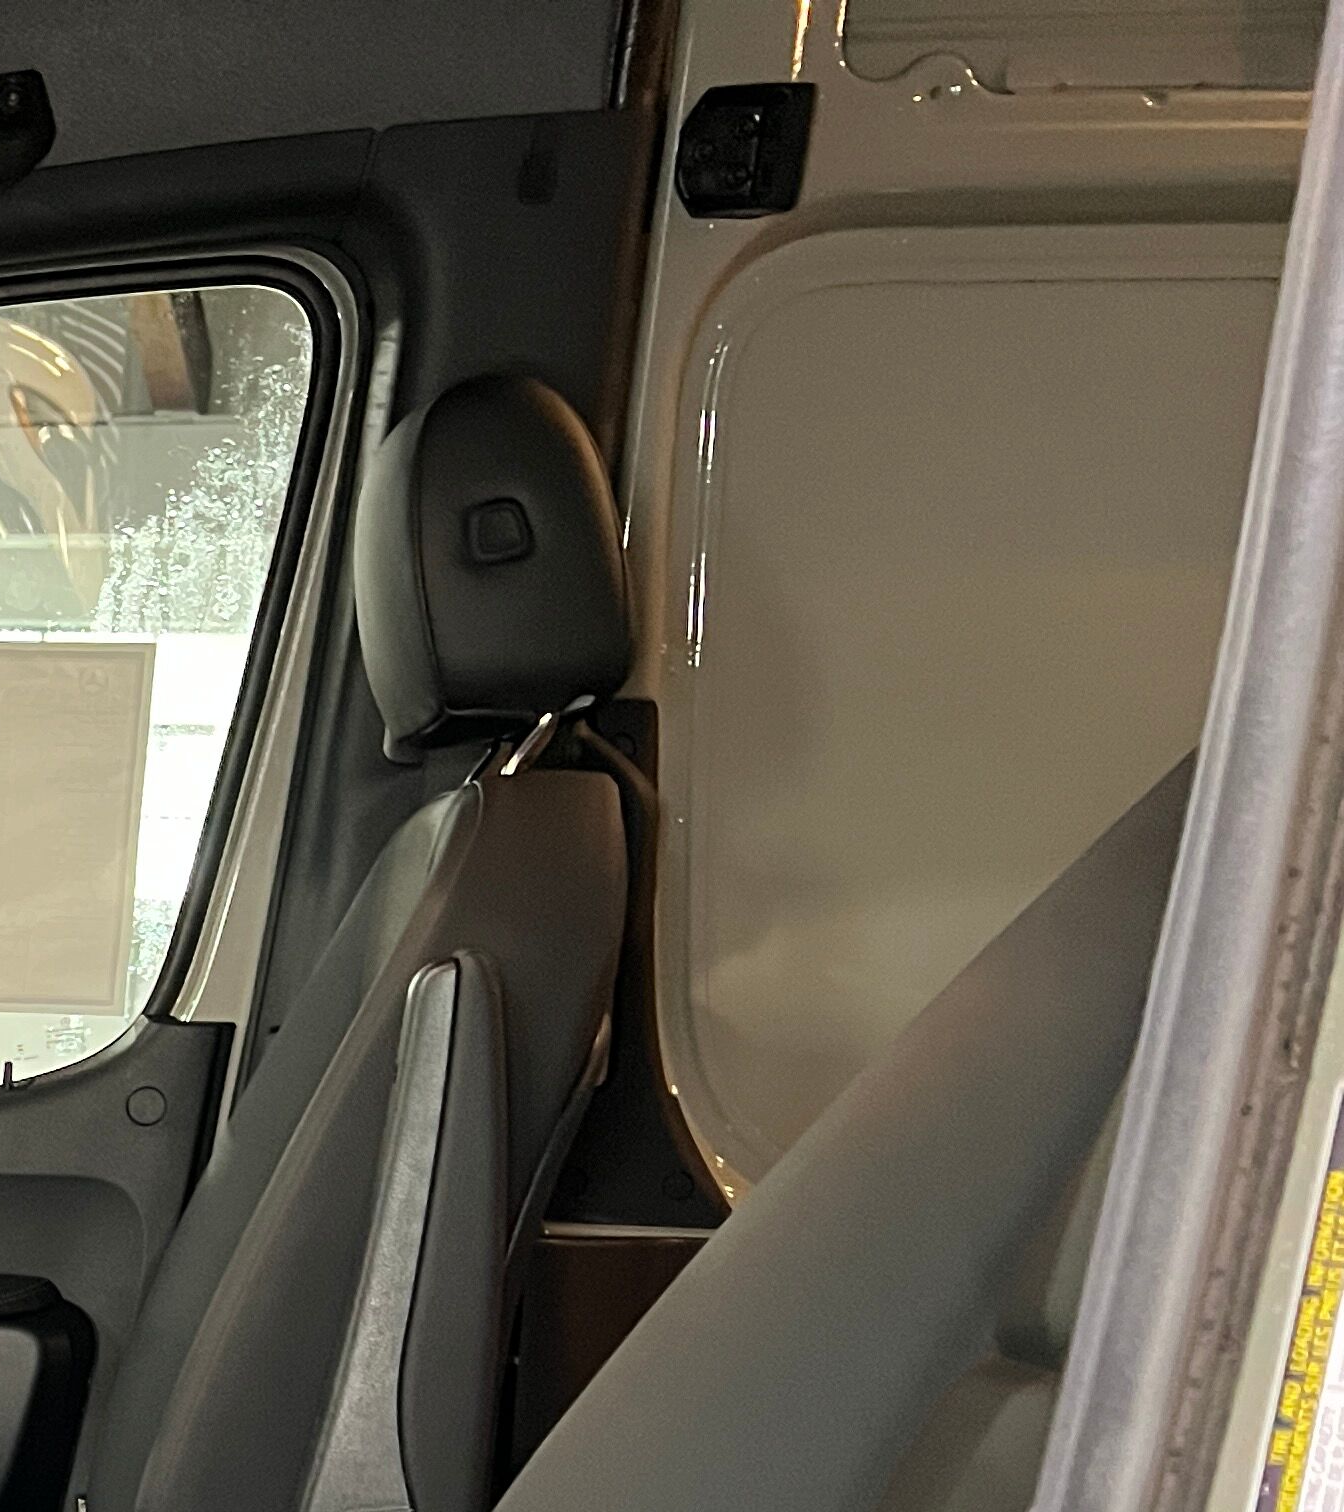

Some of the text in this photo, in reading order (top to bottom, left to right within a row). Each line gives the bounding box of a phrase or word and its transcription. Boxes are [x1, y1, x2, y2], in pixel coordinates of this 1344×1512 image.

[1306, 1170, 1344, 1287] INFORMATION
[1289, 1295, 1321, 1371] LOADING
[1312, 1326, 1333, 1357] LES
[1303, 1361, 1323, 1394] SUR
[1279, 1380, 1302, 1418] AND
